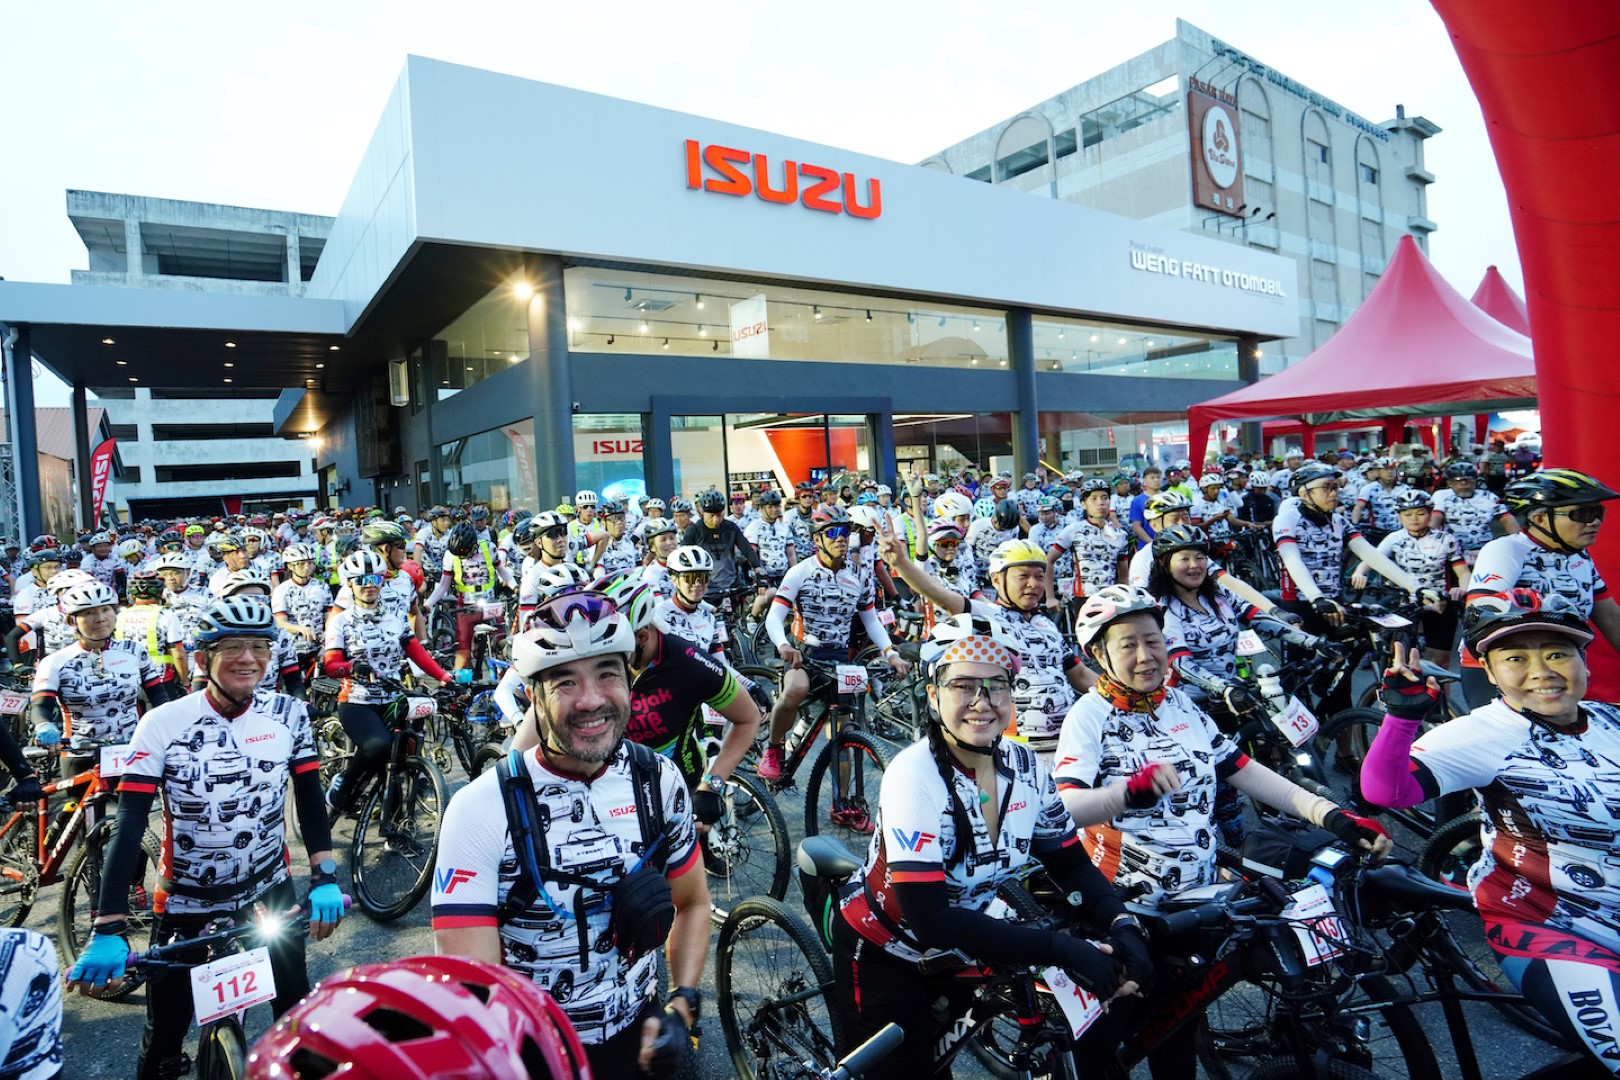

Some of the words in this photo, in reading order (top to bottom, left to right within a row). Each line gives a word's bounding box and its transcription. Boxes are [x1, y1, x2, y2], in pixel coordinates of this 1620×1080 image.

[685, 138, 882, 219] ISUZU
[1131, 250, 1179, 276] WENG
[1181, 261, 1220, 284] FATT
[1221, 269, 1286, 297] OTOMOBIL
[593, 440, 643, 454] ISUZ
[2, 698, 20, 709] 727
[630, 687, 673, 714] ojak
[1291, 711, 1312, 733] 13
[245, 733, 276, 744] ISUZU
[608, 803, 638, 818] ISUZ
[892, 827, 936, 852] WF
[212, 970, 257, 1003] 112
[933, 1008, 977, 1063] INX
